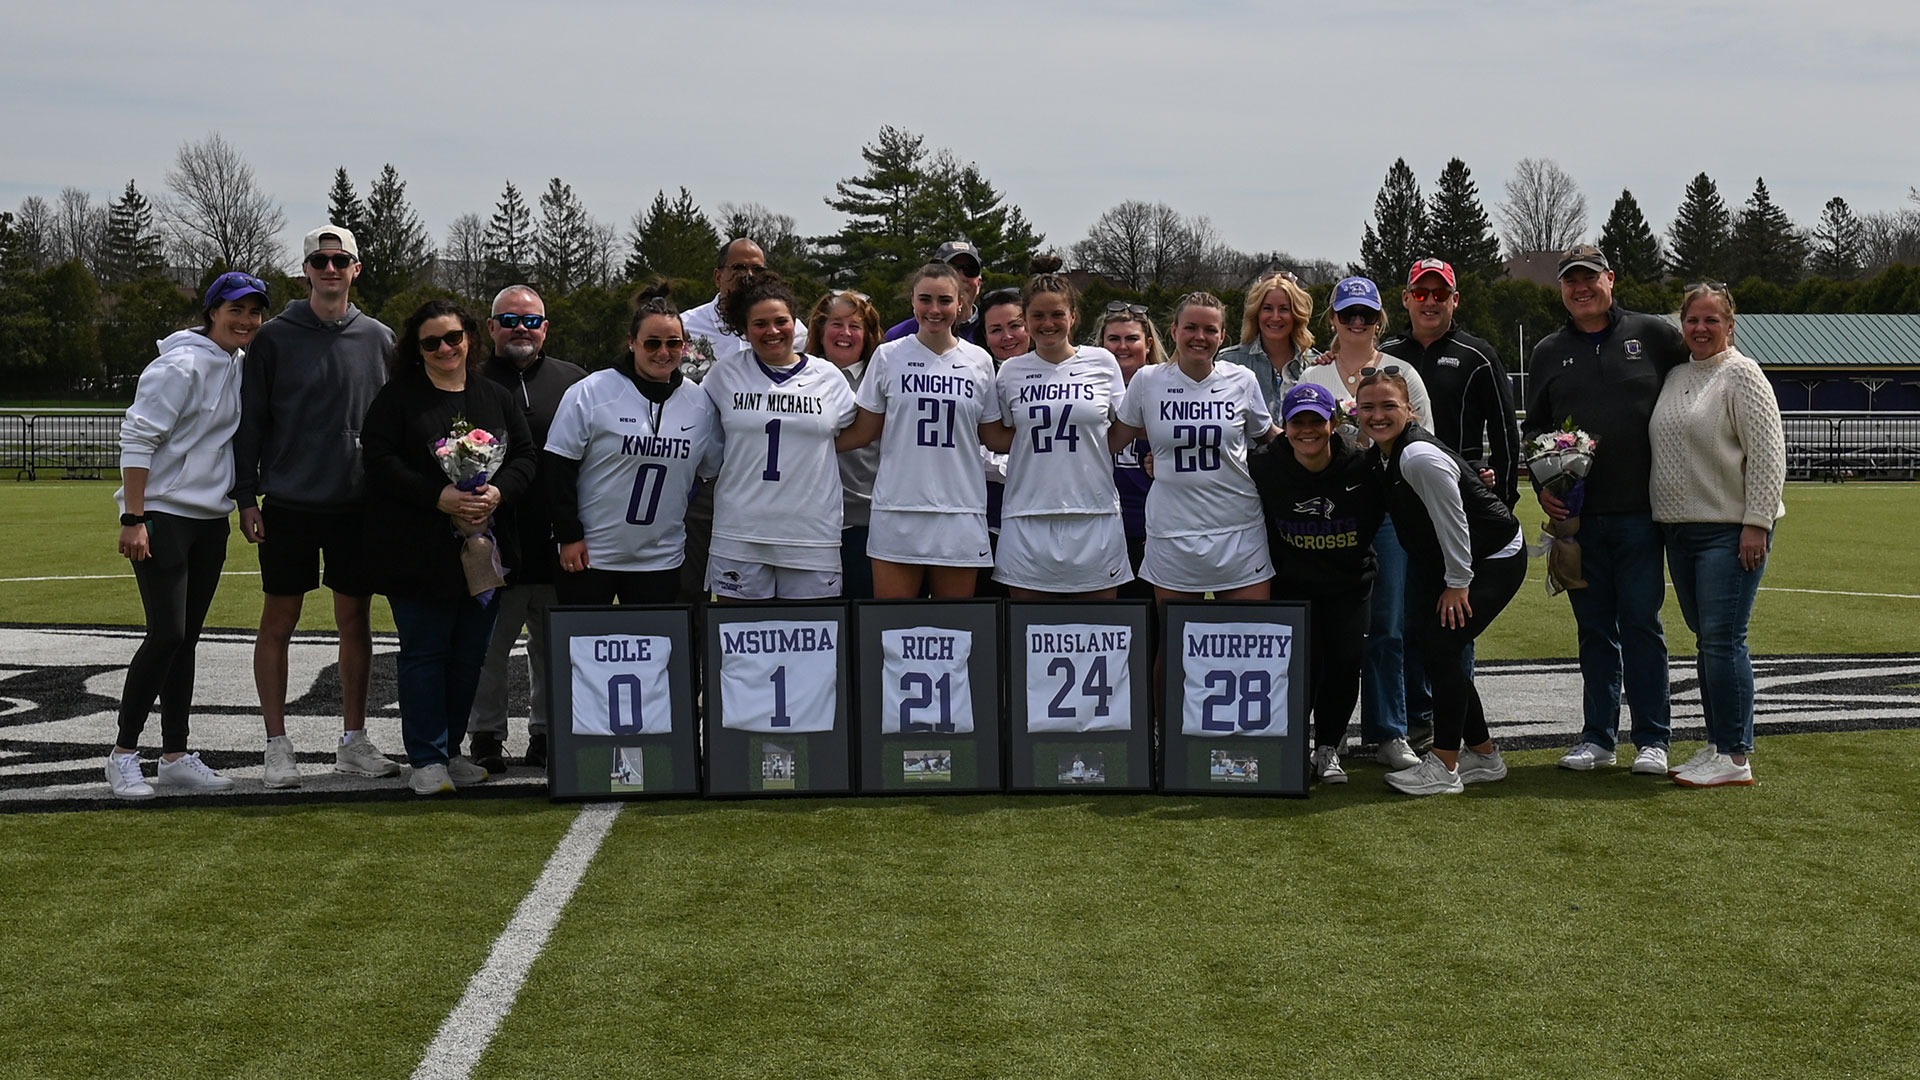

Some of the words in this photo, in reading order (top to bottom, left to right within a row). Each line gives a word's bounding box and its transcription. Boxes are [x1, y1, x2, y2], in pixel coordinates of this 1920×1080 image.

[901, 373, 975, 399] KNIGHTS
[1019, 382, 1095, 404] KNIGHTS
[732, 392, 763, 411] SAINT
[766, 394, 823, 415] MICHAEL'S
[1160, 400, 1236, 421] KNIGHTS
[917, 397, 957, 448] 21
[1029, 404, 1080, 454] 24
[620, 434, 691, 460] KNIGHTS
[762, 418, 782, 482] 1
[1173, 424, 1222, 473] 28
[624, 463, 668, 526] 0
[1278, 527, 1359, 550] LACROSSE
[594, 638, 652, 663] COLE
[724, 627, 835, 655] MSUMBA
[901, 635, 955, 661] RICH
[1031, 631, 1128, 654] DRISLANE
[1187, 633, 1292, 659] MURPHY
[769, 665, 791, 728] 1
[1046, 655, 1113, 719] 24
[1201, 669, 1272, 732] 28
[607, 673, 643, 735] 0
[900, 671, 955, 733] 21
